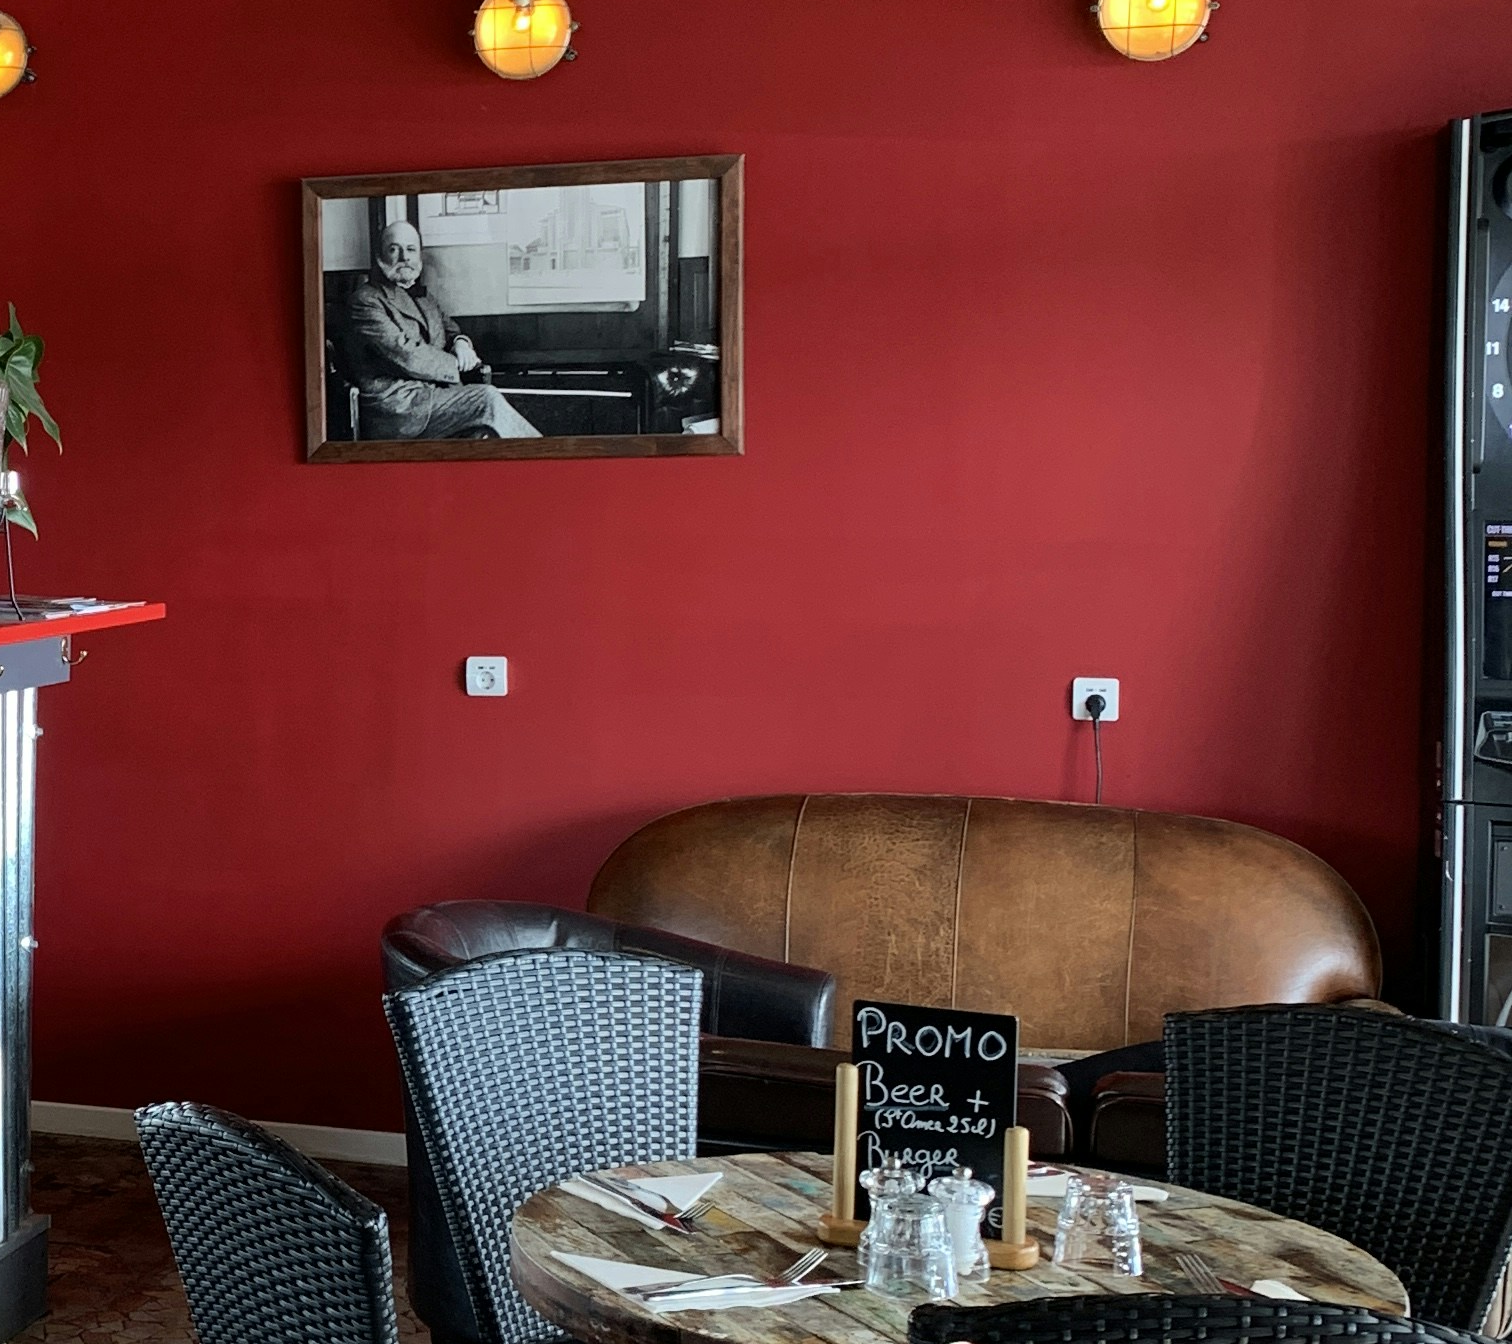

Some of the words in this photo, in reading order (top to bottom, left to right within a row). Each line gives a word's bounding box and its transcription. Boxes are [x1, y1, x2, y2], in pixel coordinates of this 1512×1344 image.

[1492, 299, 1510, 313] 14
[1485, 342, 1500, 355] 11
[1492, 384, 1504, 399] 8
[857, 1007, 1008, 1061] PROMO
[855, 1060, 950, 1107] Beer
[966, 1089, 990, 1113] +
